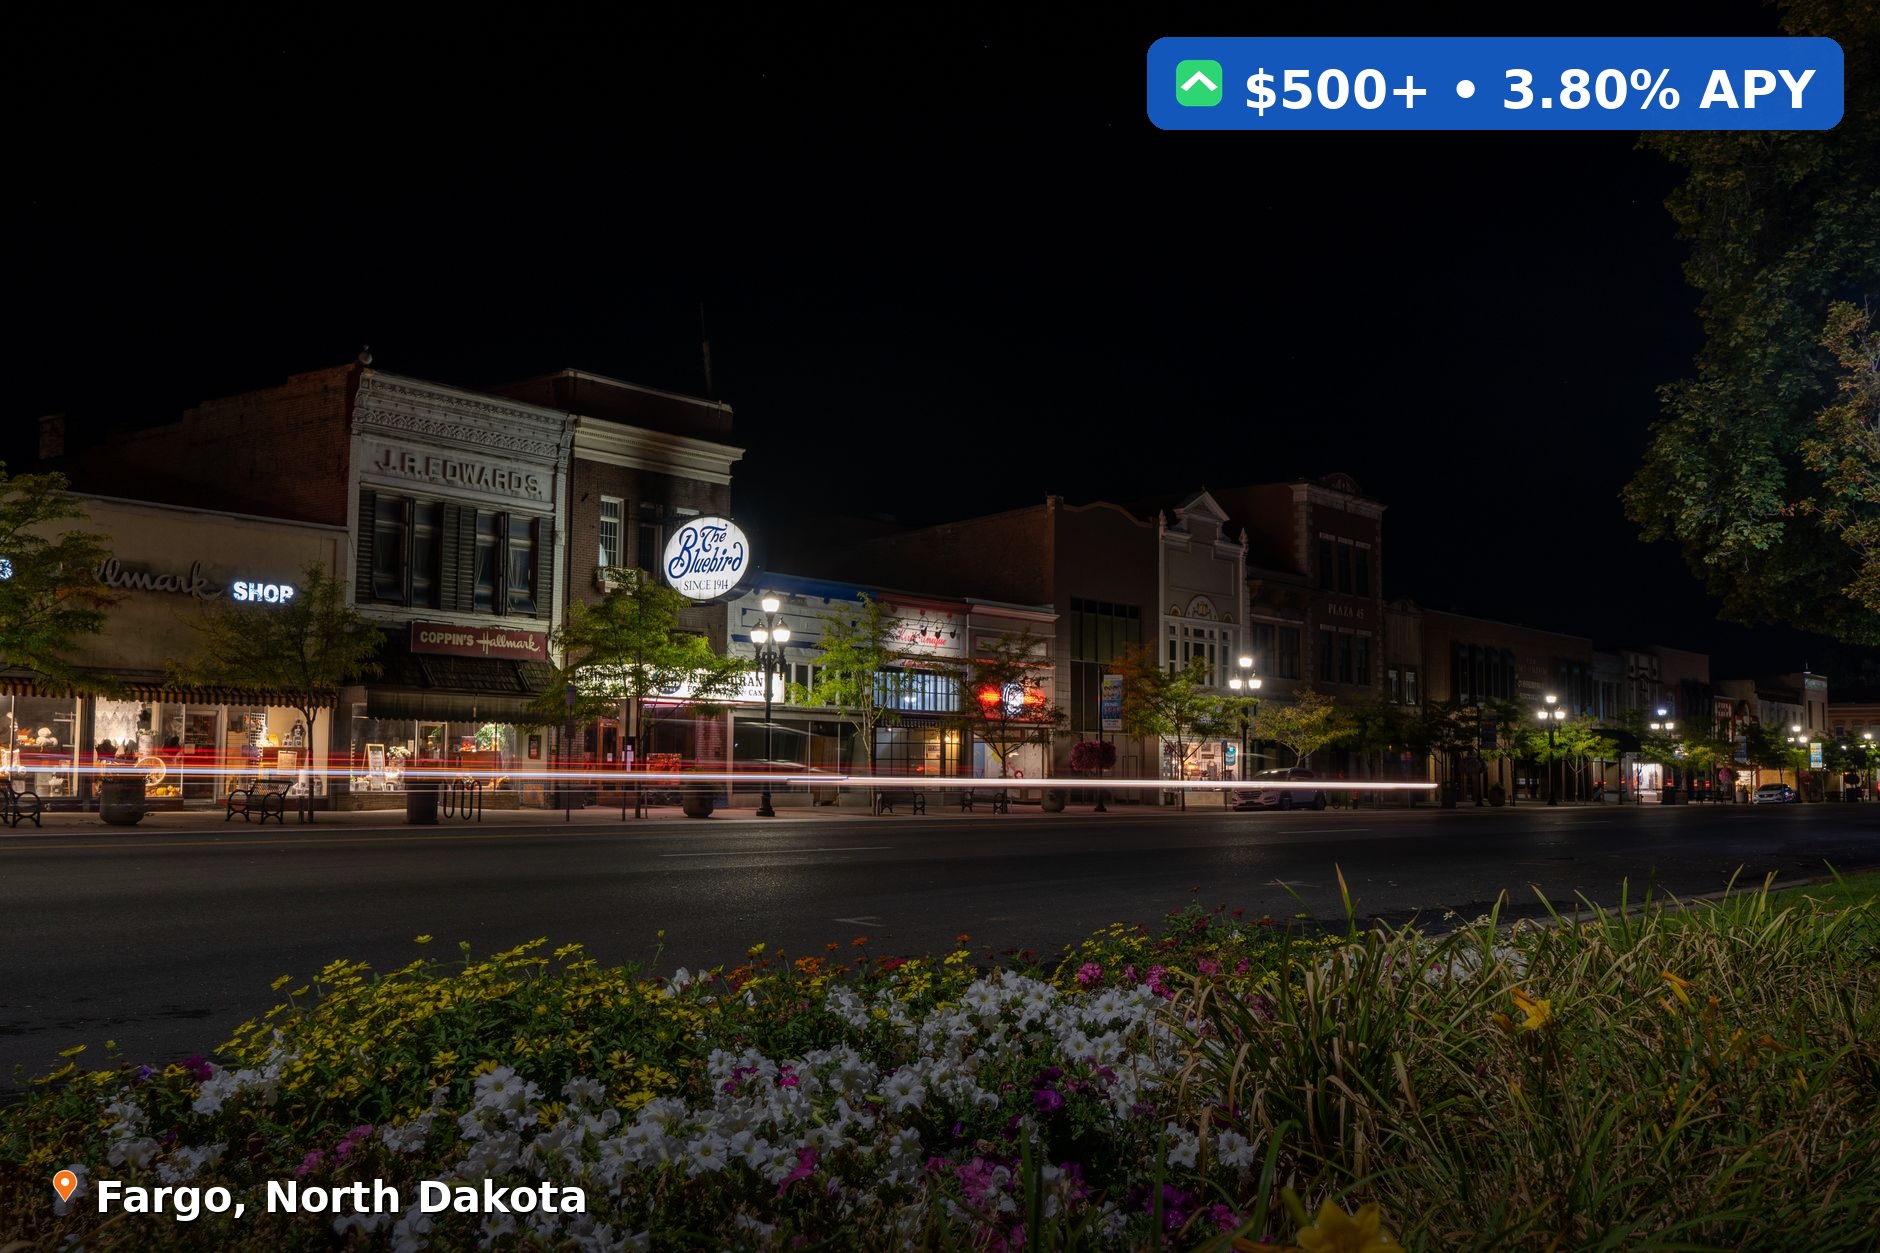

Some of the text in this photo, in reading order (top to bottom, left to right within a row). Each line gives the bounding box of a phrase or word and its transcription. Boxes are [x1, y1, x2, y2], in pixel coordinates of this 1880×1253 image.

[700, 523, 727, 552] The
[668, 527, 743, 579] Bluebird
[233, 581, 294, 603] SHOP
[683, 579, 728, 591] SINCE 1914
[419, 631, 474, 646] COPPIN'S
